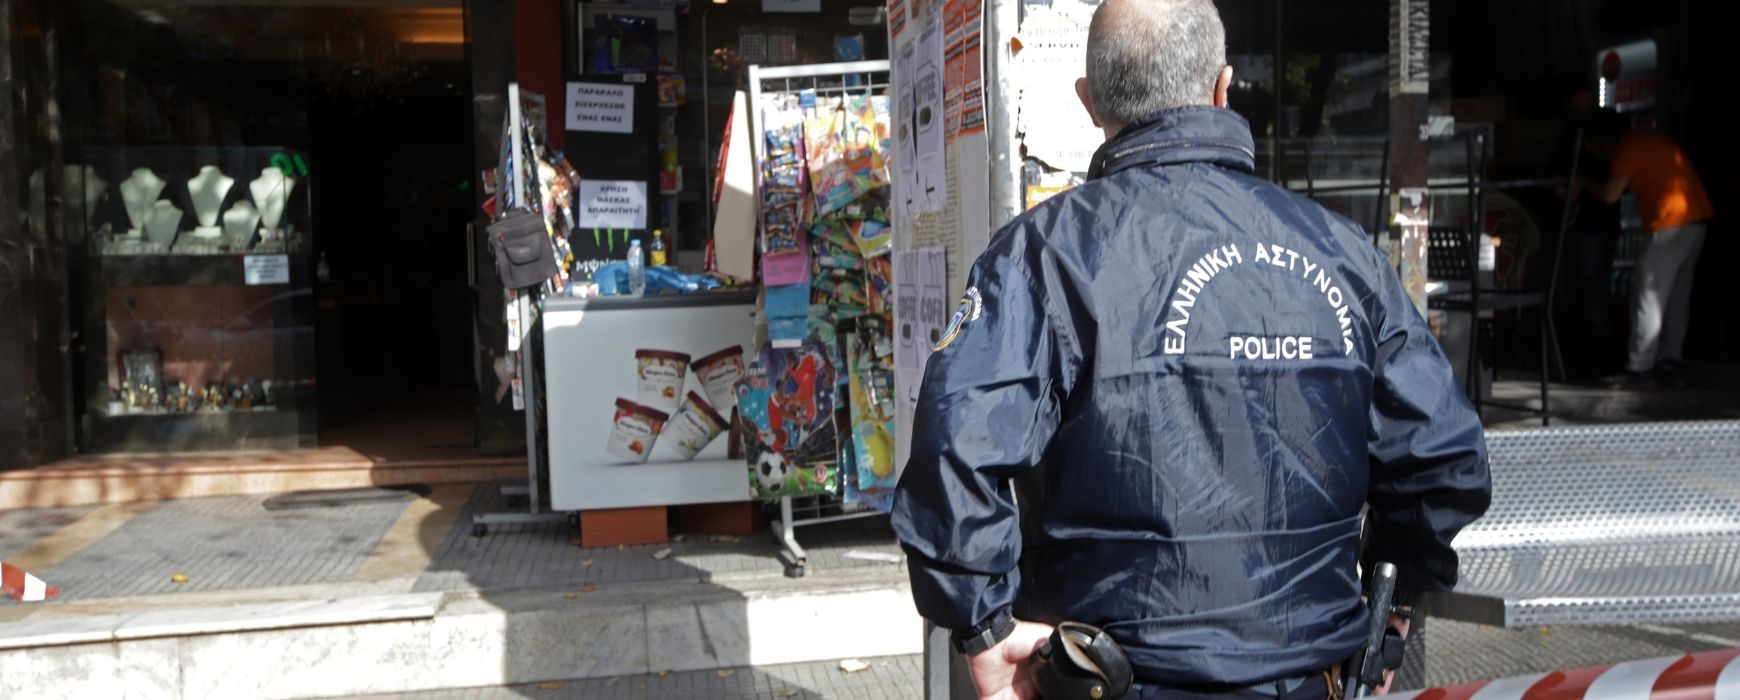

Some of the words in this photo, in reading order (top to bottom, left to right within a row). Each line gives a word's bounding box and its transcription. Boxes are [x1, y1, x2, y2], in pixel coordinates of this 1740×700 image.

[577, 87, 624, 97] ΠΑΡΑΚΑΛΩ
[601, 115, 623, 123] ΕΝΑΣ
[600, 185, 628, 193] ΧΡΗΣΗ
[587, 207, 641, 215] ΑΠΑΡΑΙΤΗΤΗ
[1164, 243, 1243, 355] ΕΛΛΗΝΙΚΗ
[1255, 242, 1354, 356] ΑΣΤΥΝΟΜΙΑ
[1229, 336, 1313, 360] POLICE
